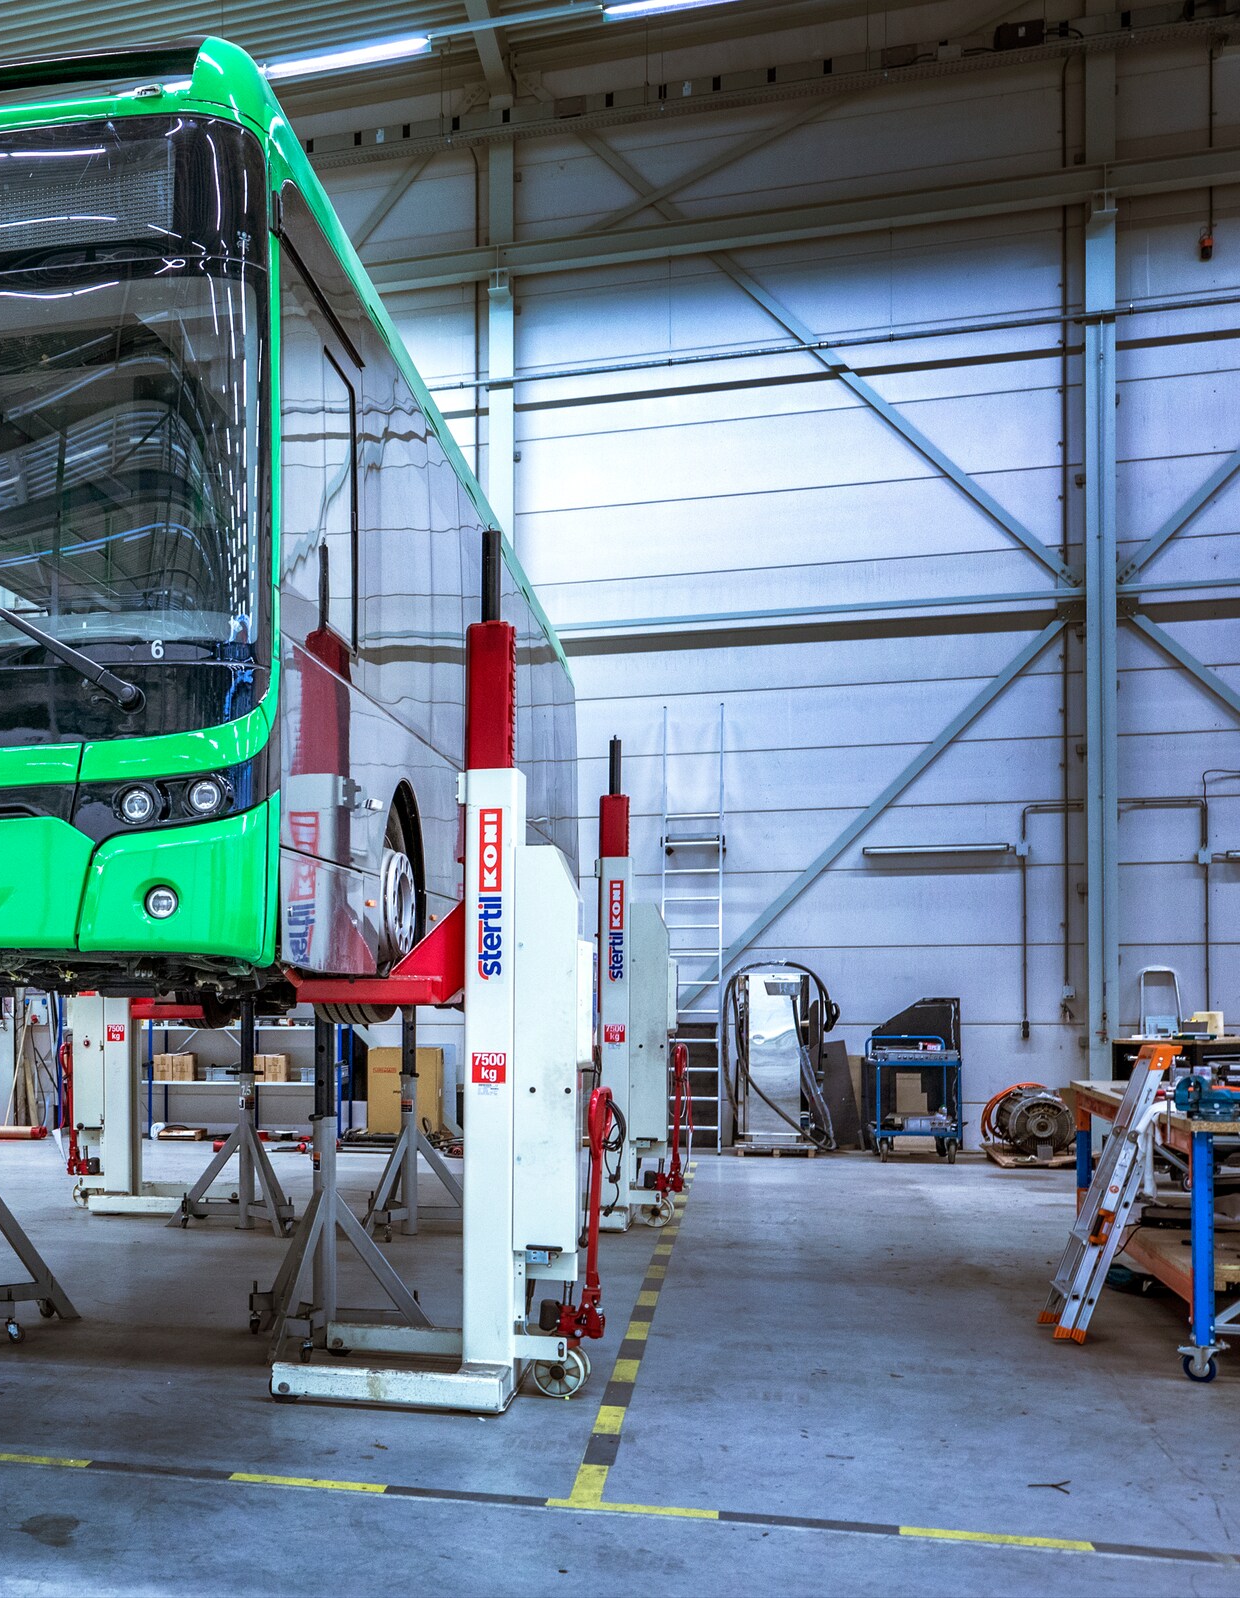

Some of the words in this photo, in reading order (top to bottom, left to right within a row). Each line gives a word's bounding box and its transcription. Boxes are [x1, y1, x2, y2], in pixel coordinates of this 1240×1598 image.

[151, 639, 164, 658] 6
[482, 812, 499, 889] KONI
[611, 882, 622, 928] KONI
[478, 897, 502, 979] stertil
[609, 932, 623, 980] stertil
[107, 1025, 124, 1033] 7500
[111, 1033, 121, 1041] kg
[610, 1033, 620, 1041] kg
[473, 1053, 505, 1066] 7500
[481, 1066, 497, 1082] kg
